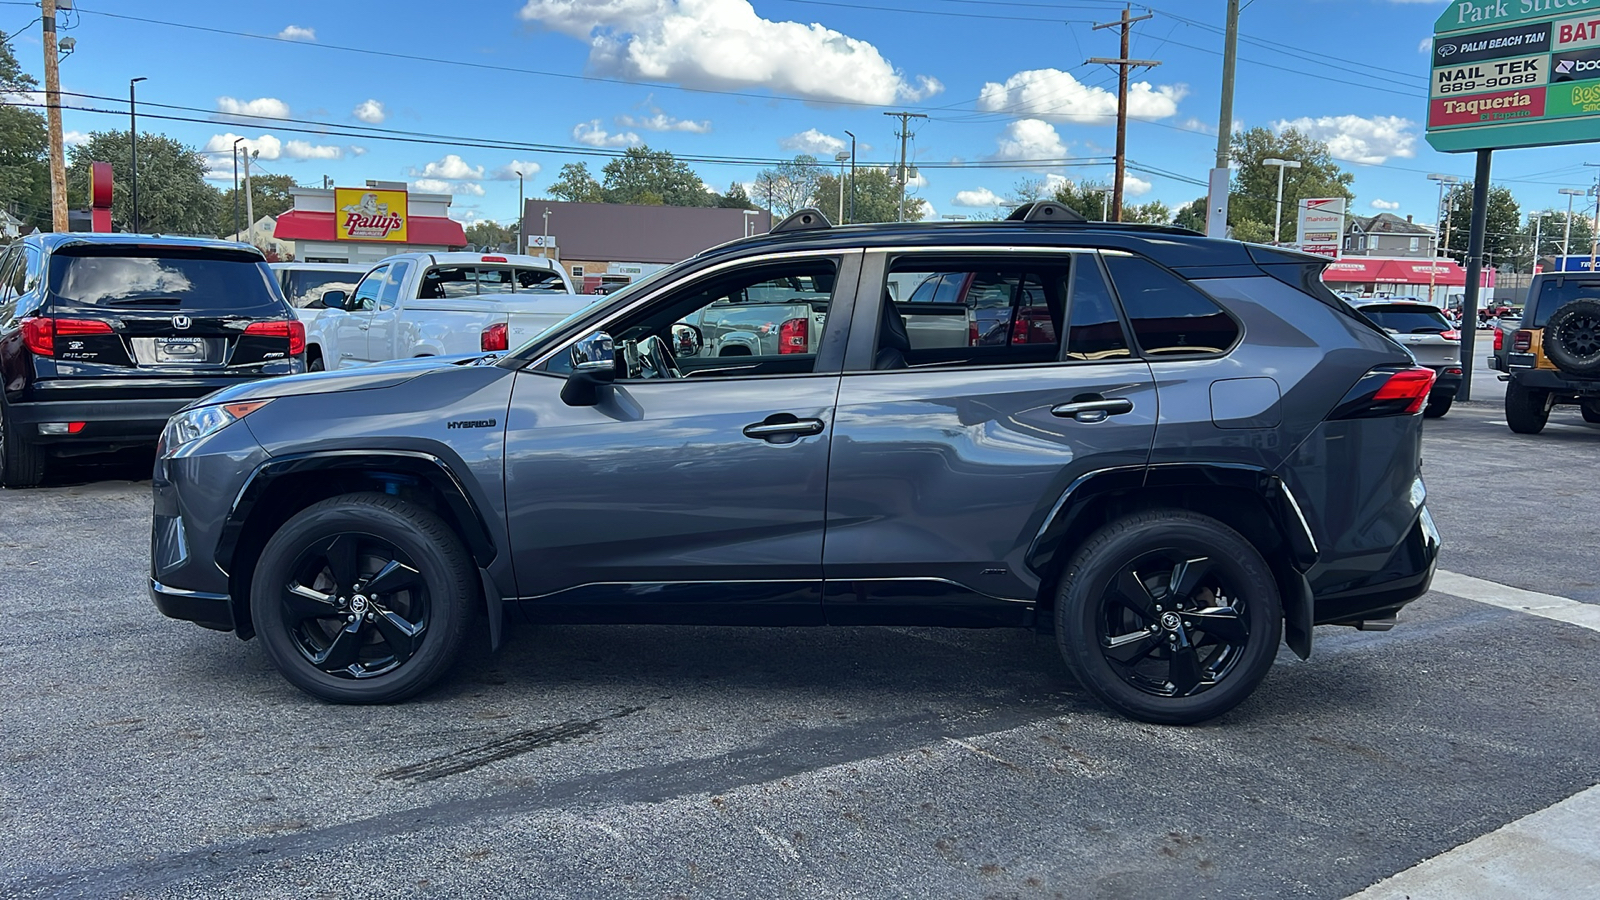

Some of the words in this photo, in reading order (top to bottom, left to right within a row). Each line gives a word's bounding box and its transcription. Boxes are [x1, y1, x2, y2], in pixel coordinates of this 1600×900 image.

[1457, 0, 1508, 23] Park
[1520, 0, 1590, 13] Stre
[1460, 40, 1487, 53] PALM
[1488, 35, 1523, 49] BEACH
[1525, 32, 1546, 43] TAN
[1559, 20, 1600, 43] BAT
[1438, 67, 1485, 83] NAIL
[1494, 59, 1539, 75] TEK
[1440, 73, 1537, 93] 689-9088
[343, 211, 402, 237] Rally's
